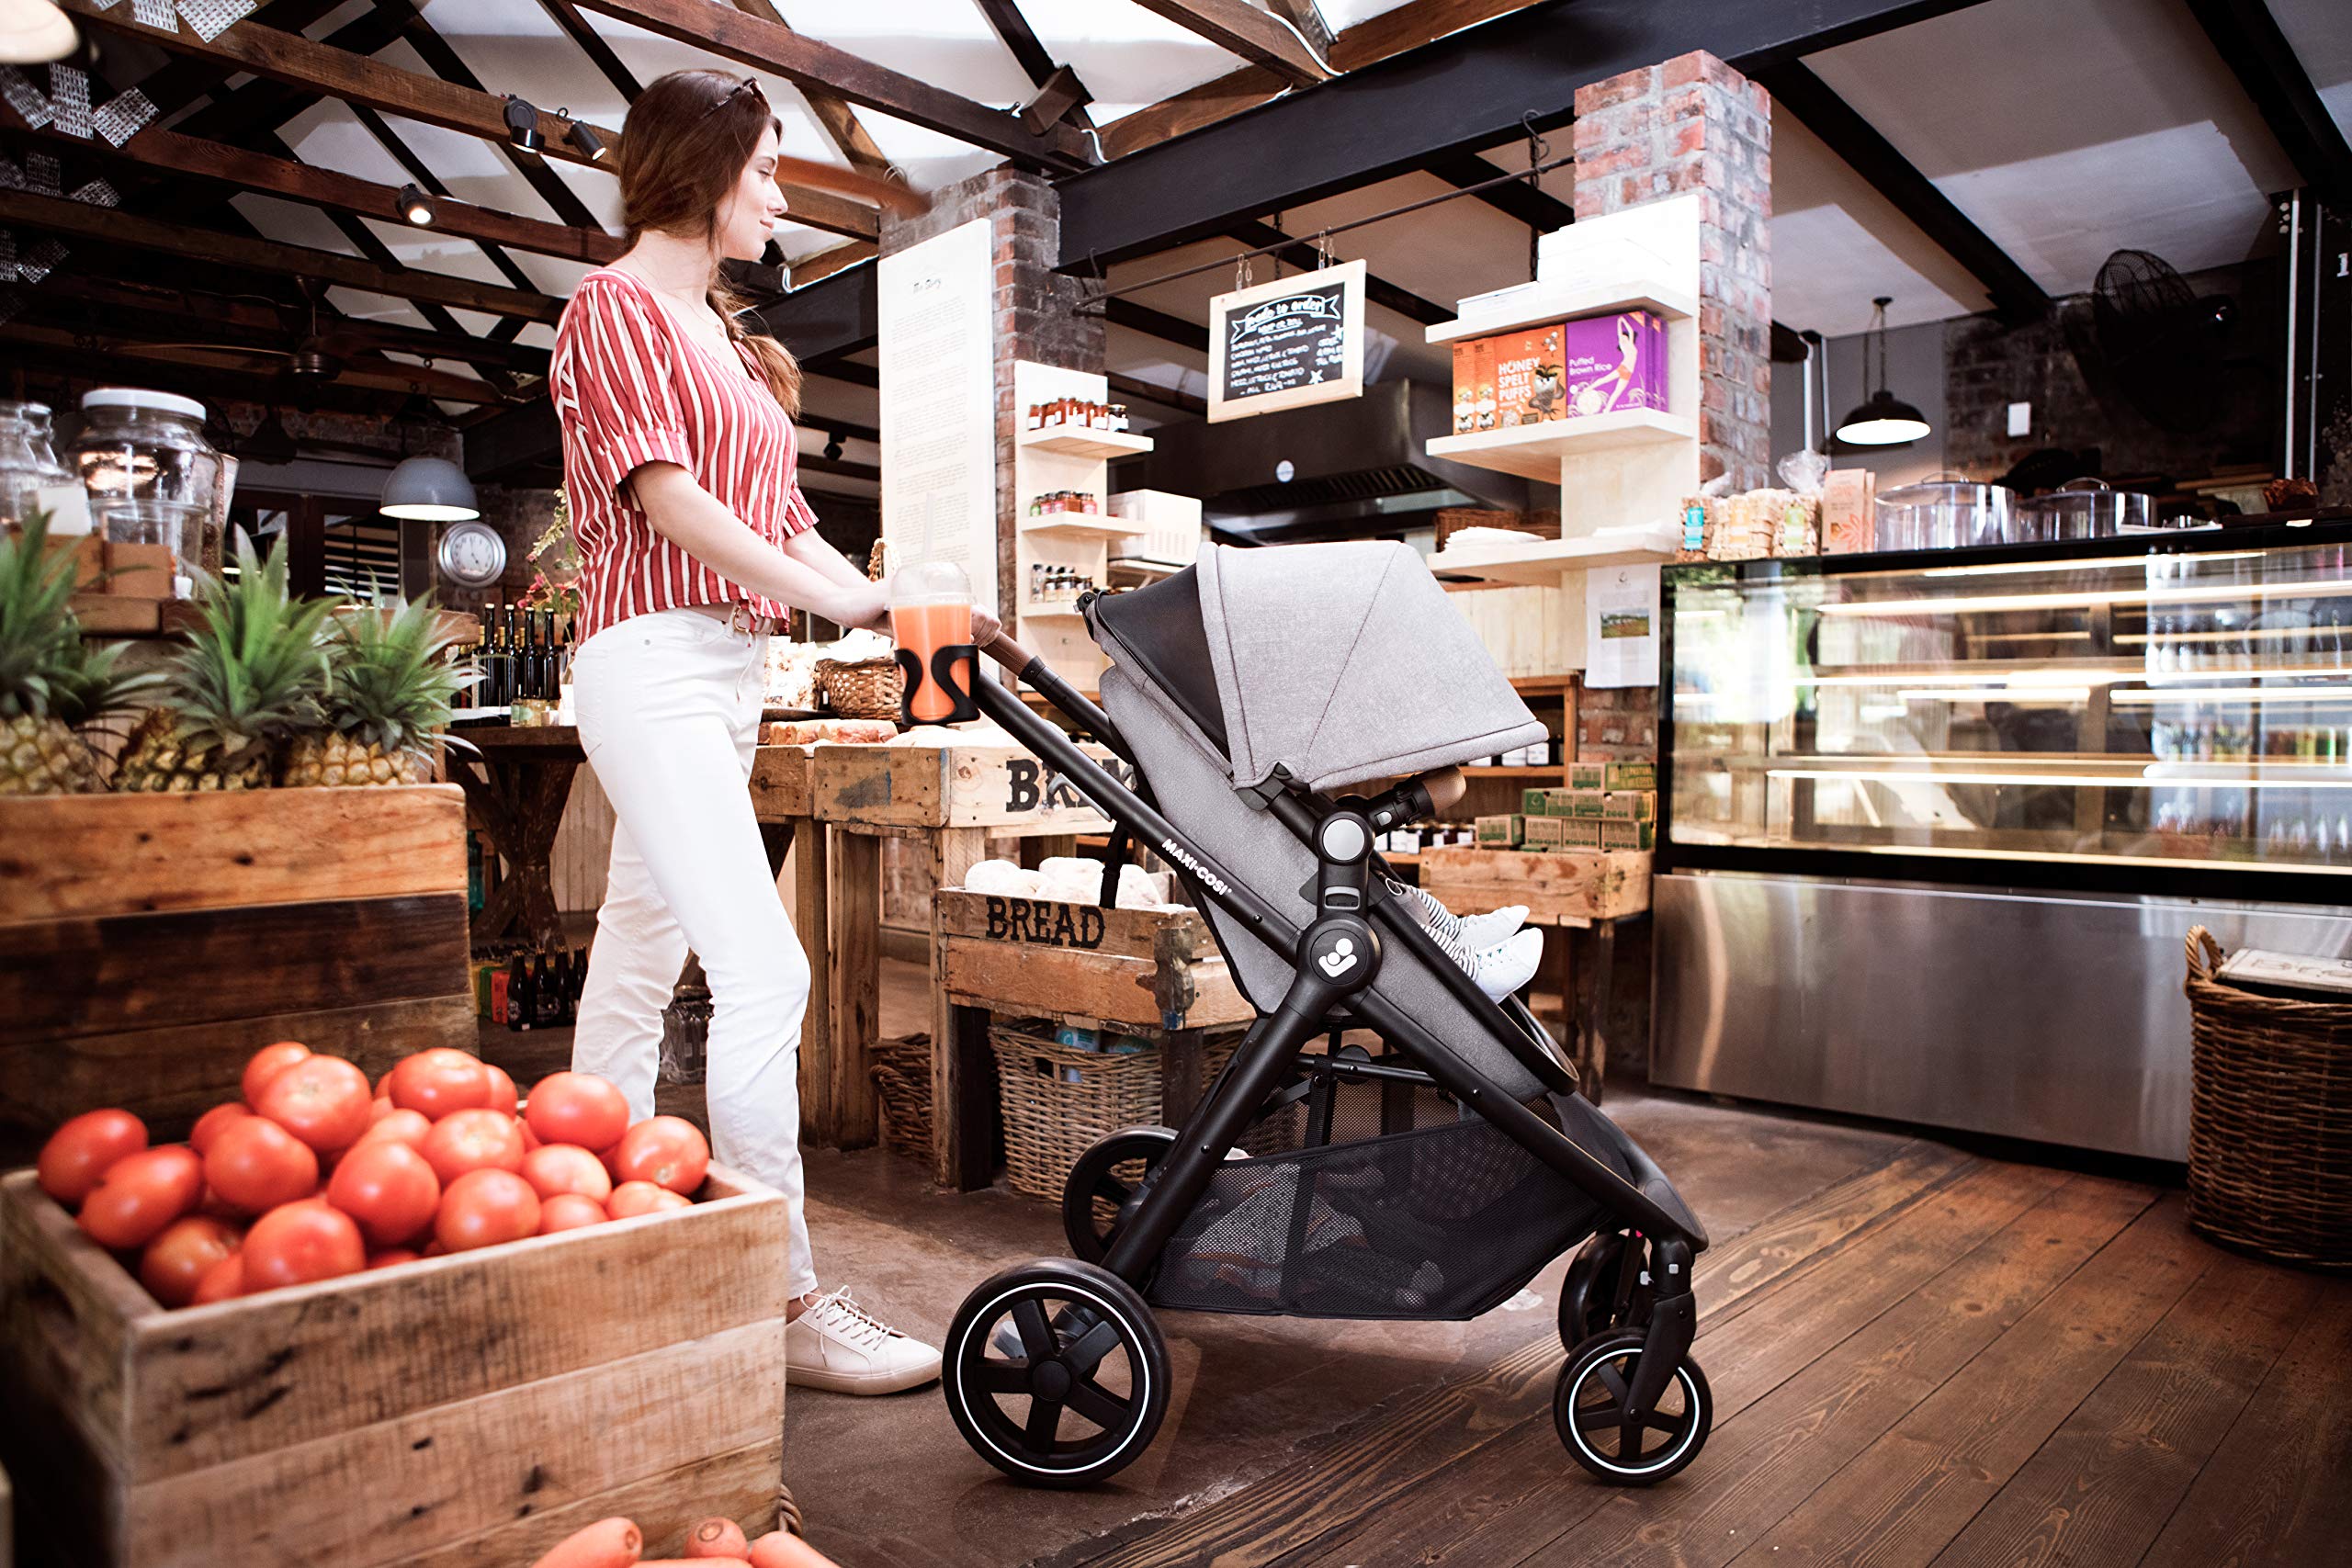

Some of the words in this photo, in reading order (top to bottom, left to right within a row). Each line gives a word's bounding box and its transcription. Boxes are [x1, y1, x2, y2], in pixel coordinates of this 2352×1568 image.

[1498, 357, 1541, 376] HONEY
[1498, 372, 1530, 389] SPELT
[1498, 386, 1532, 402] PUFFS
[985, 897, 1105, 949] BREAD
